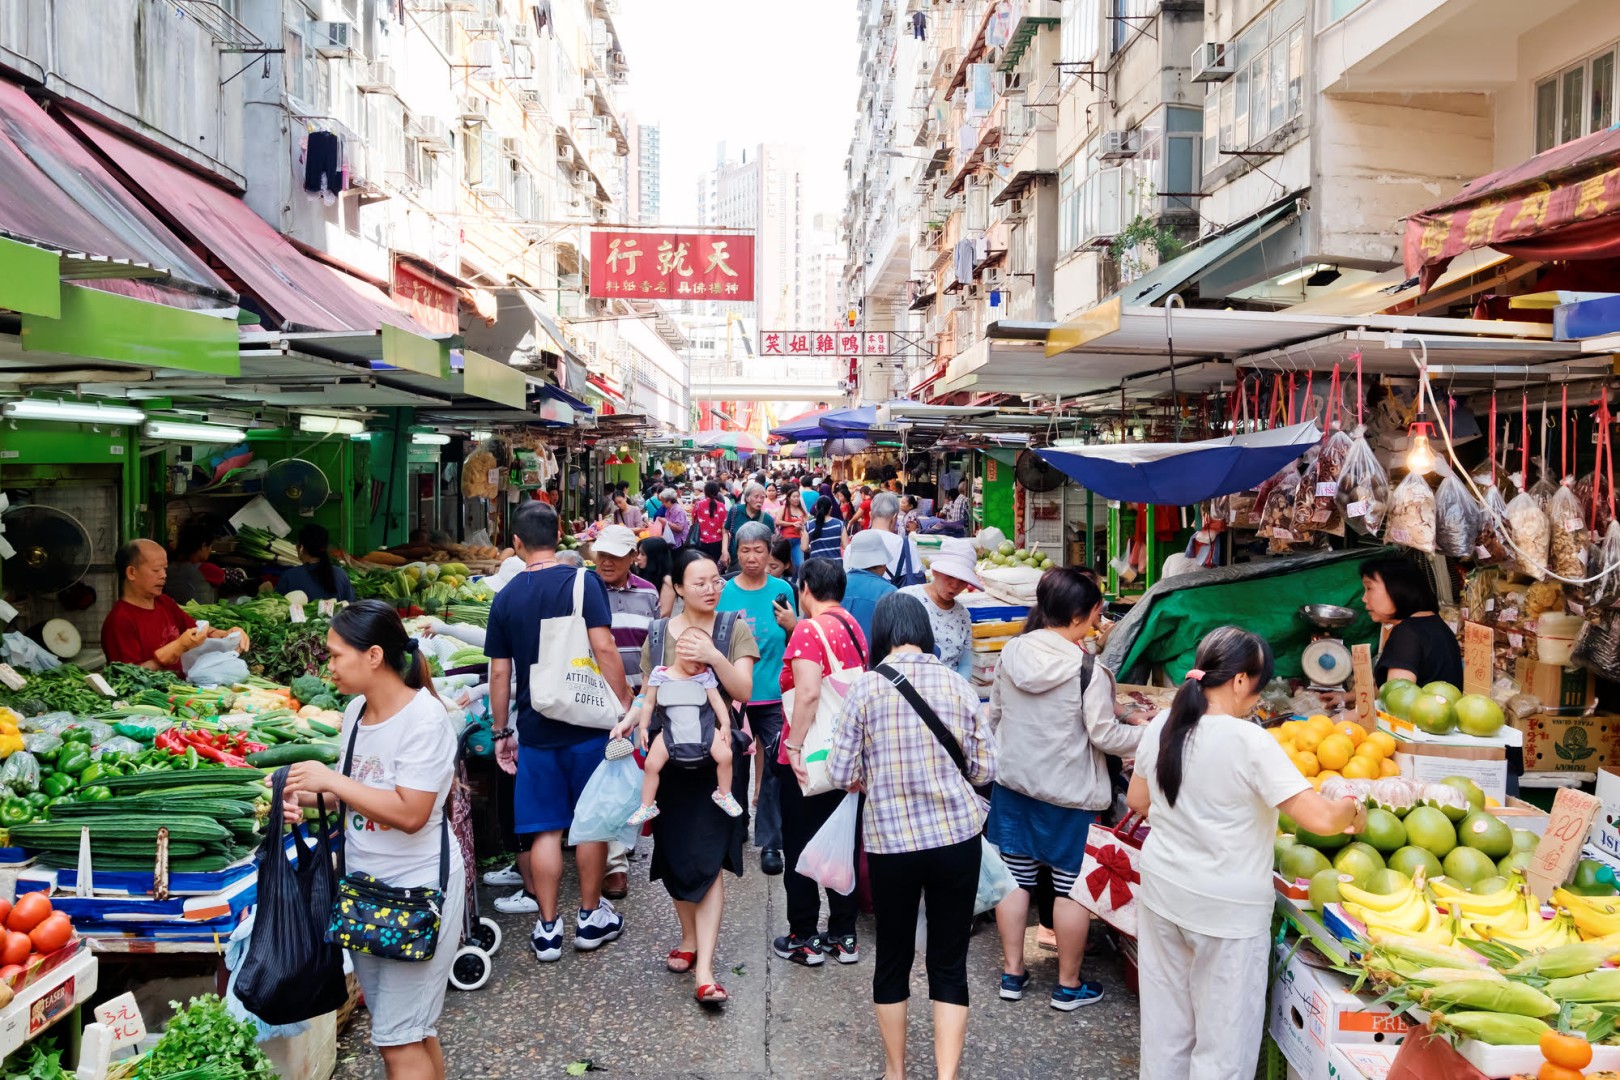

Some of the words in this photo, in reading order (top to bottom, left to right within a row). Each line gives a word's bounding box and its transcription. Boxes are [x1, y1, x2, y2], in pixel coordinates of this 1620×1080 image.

[765, 333, 859, 354] 笑姐雞鴨
[566, 672, 598, 688] ATTITUDE
[575, 692, 605, 707] COFFEE
[1554, 815, 1583, 841] 20
